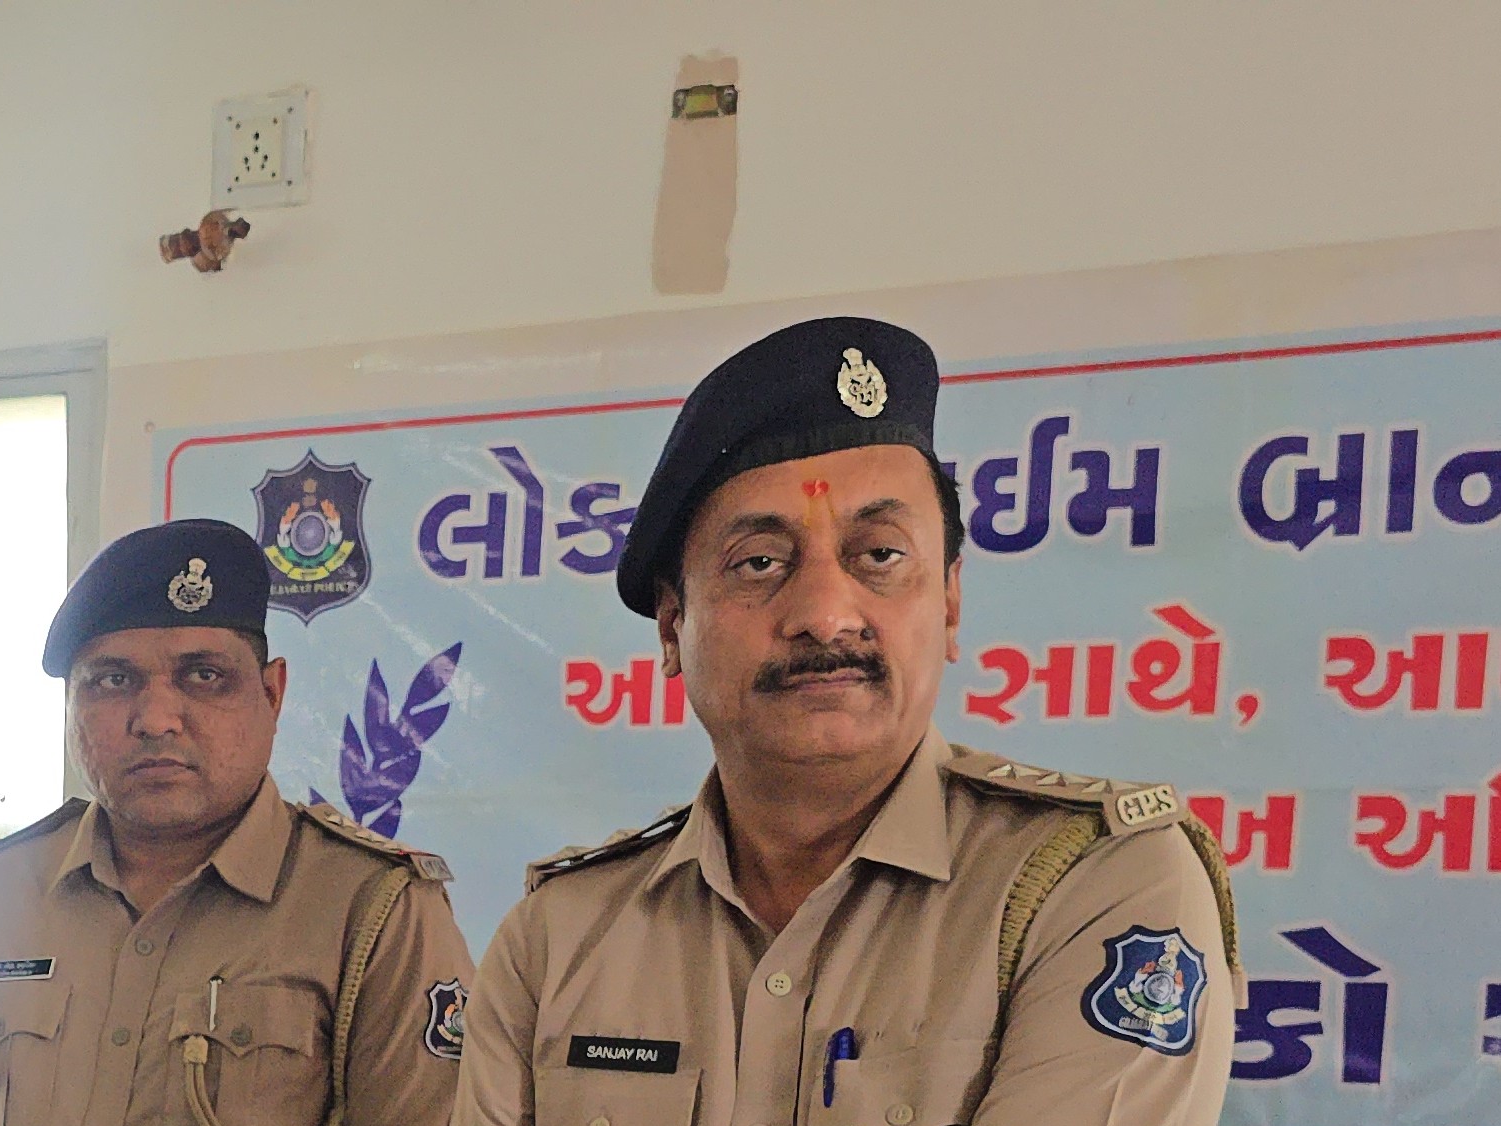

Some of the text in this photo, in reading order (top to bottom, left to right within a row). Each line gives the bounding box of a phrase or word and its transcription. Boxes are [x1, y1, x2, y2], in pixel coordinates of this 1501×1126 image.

[419, 446, 638, 579] લોક
[565, 605, 1499, 726] આ સાથે, આ
[586, 1045, 659, 1062] SANJAY RAI
[1230, 926, 1388, 1084] કો
